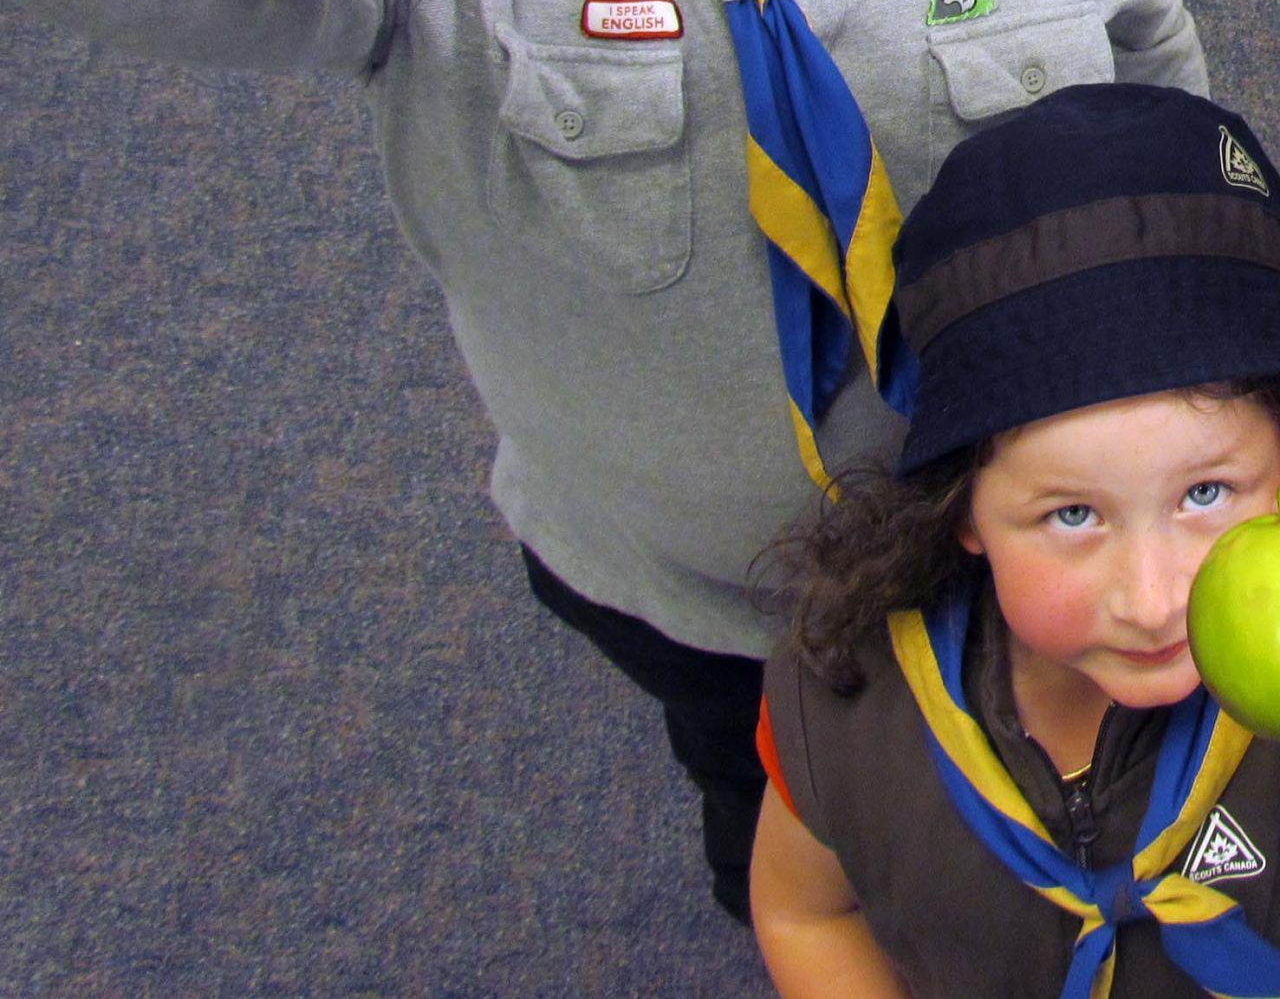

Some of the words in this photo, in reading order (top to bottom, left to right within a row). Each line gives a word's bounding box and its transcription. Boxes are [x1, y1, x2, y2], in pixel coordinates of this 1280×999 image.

[609, 6, 613, 17] I
[616, 5, 655, 16] SPEAK
[601, 17, 664, 30] ENGLISH
[1224, 859, 1258, 872] CANADA
